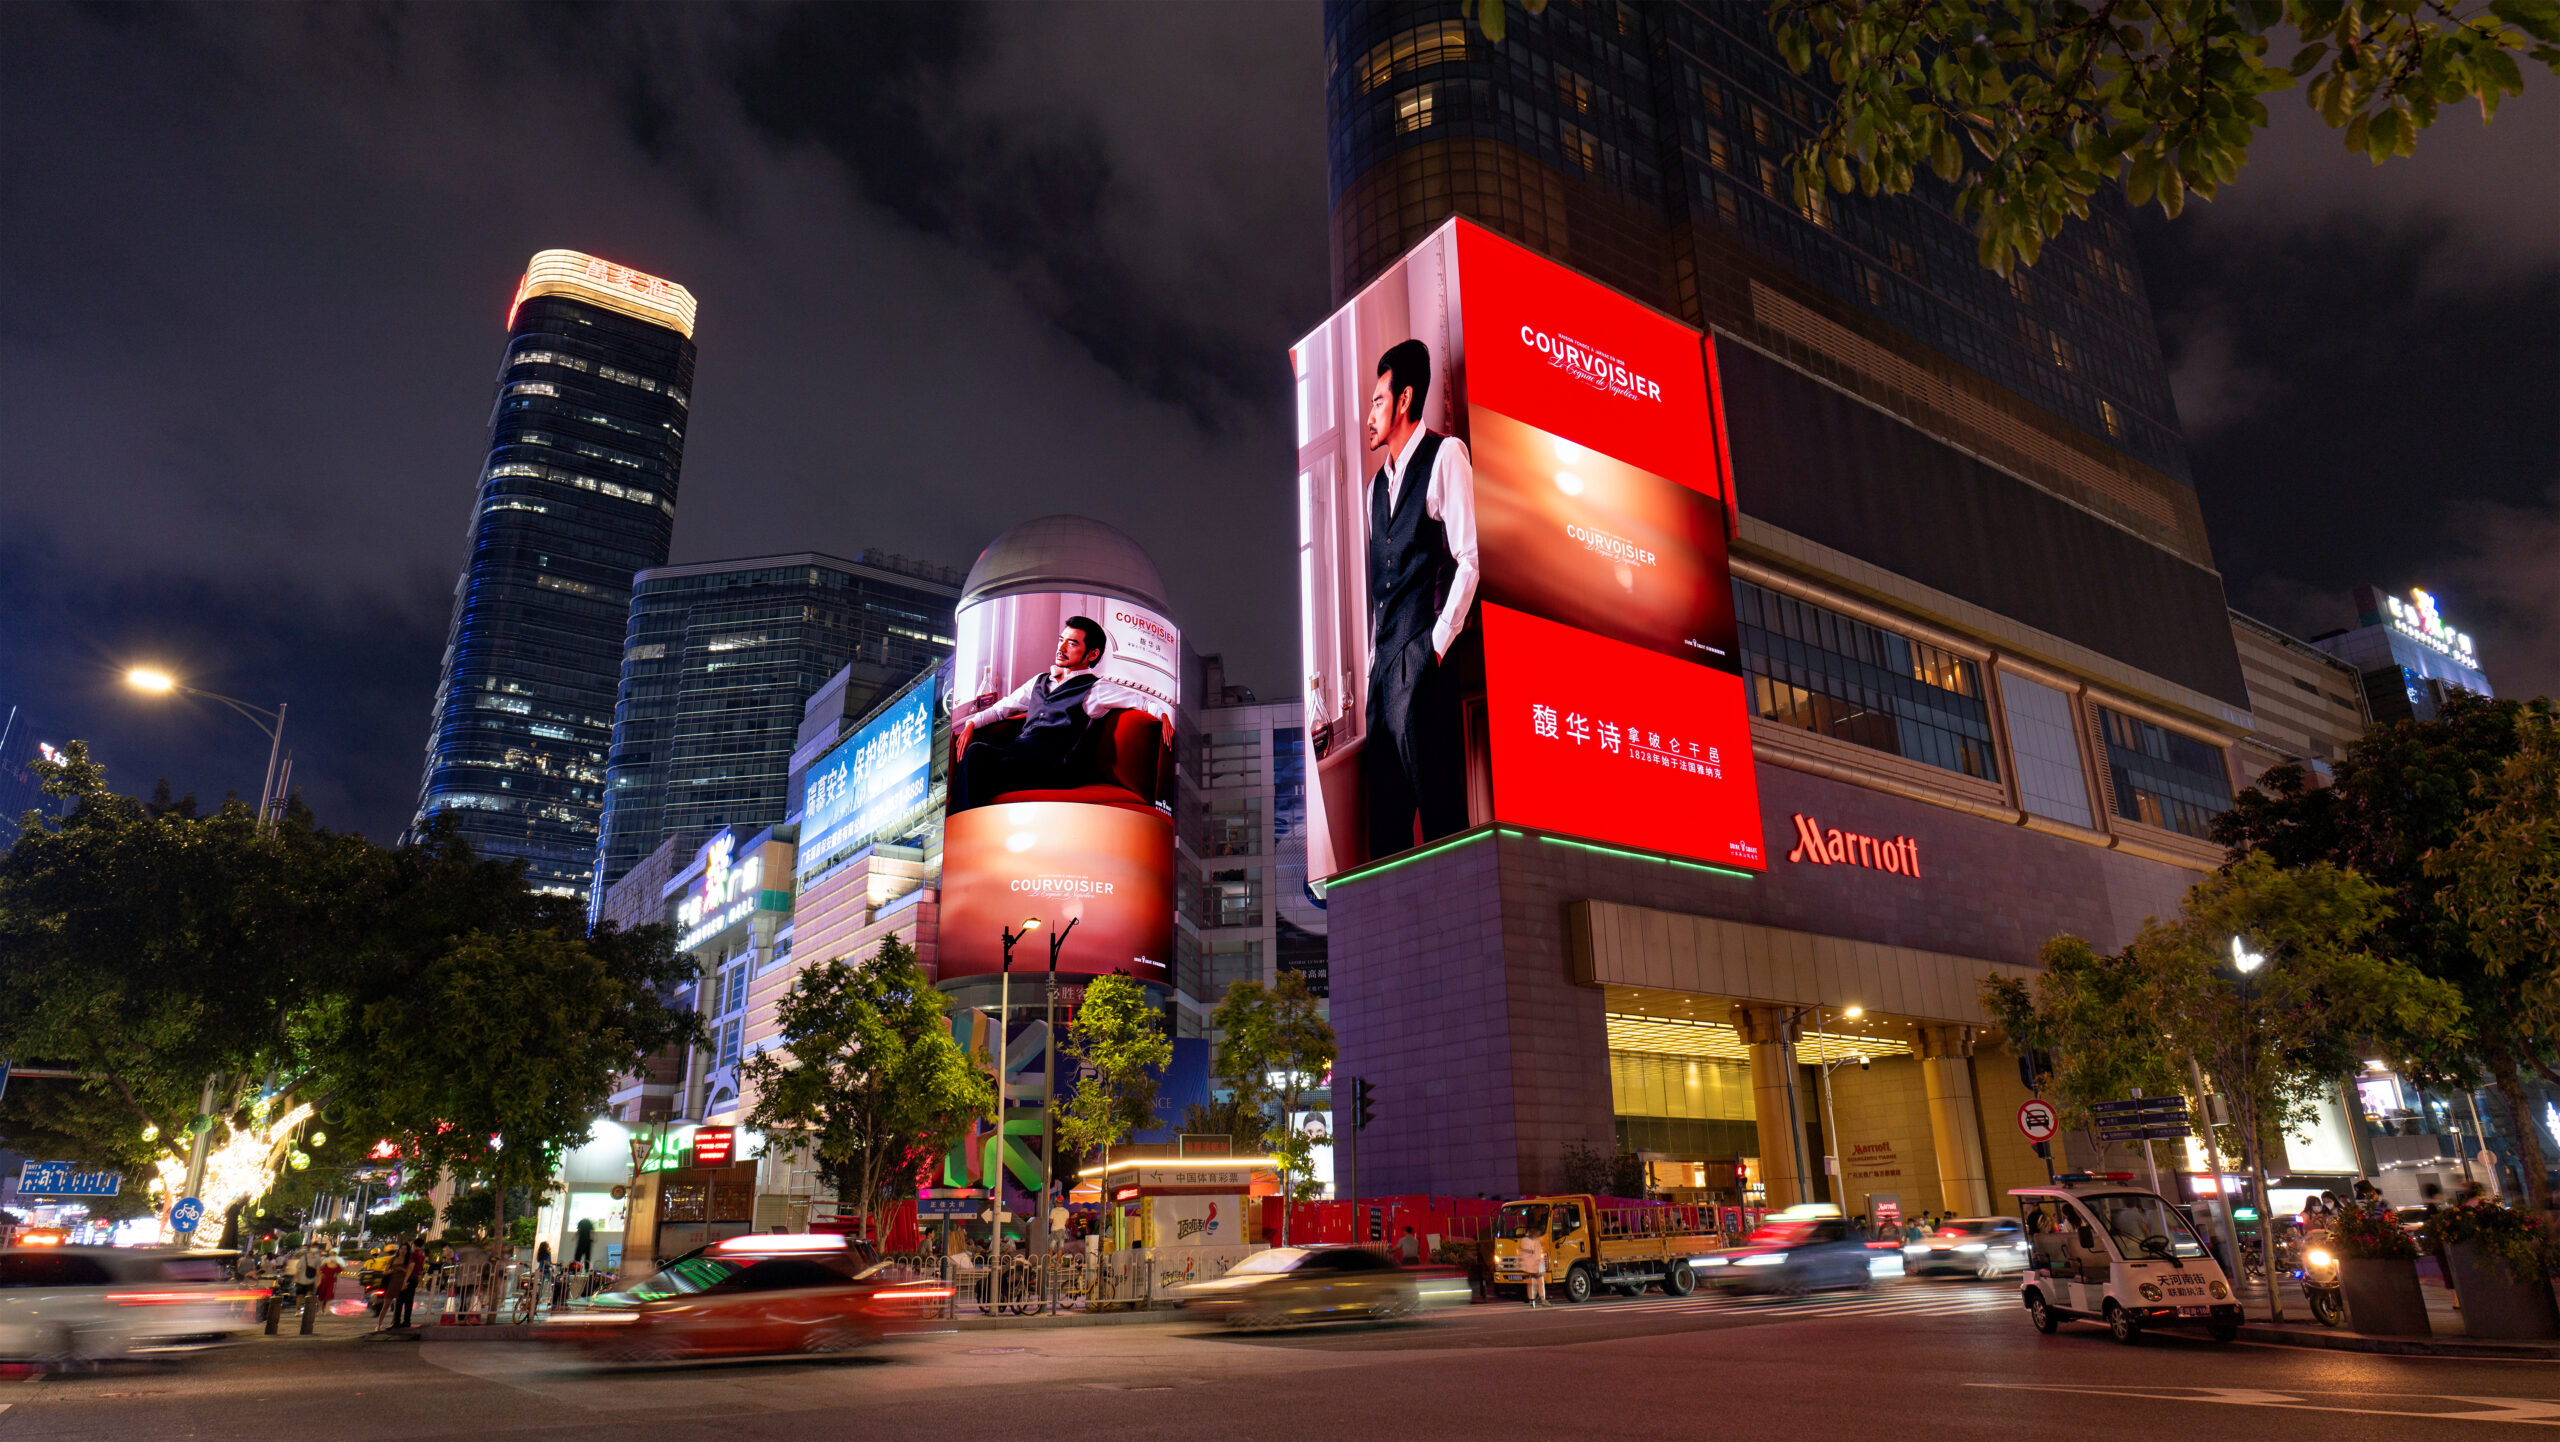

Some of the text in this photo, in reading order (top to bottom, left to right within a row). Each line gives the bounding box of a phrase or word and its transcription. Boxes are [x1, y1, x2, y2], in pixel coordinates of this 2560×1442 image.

[1521, 325, 1662, 402] COURVOISIER
[1566, 363, 1596, 380] Cognac
[1567, 524, 1656, 567] COURVOISIER
[1116, 612, 1175, 645] COURVOISIER
[1532, 703, 1621, 754] 馥华诗
[1627, 726, 1720, 764] 拿破仑干邑
[1629, 748, 1722, 780] 1828年始于法国雅纳克
[1788, 813, 1921, 878] Marriott
[1010, 879, 1114, 894] COURVOISIER
[637, 1146, 644, 1158] 让
[1852, 1141, 1890, 1156] Marriott
[1176, 1172, 1238, 1183] 中国体育彩票
[2157, 1273, 2206, 1286] 天河南街
[2168, 1287, 2205, 1296] 联勤执法
